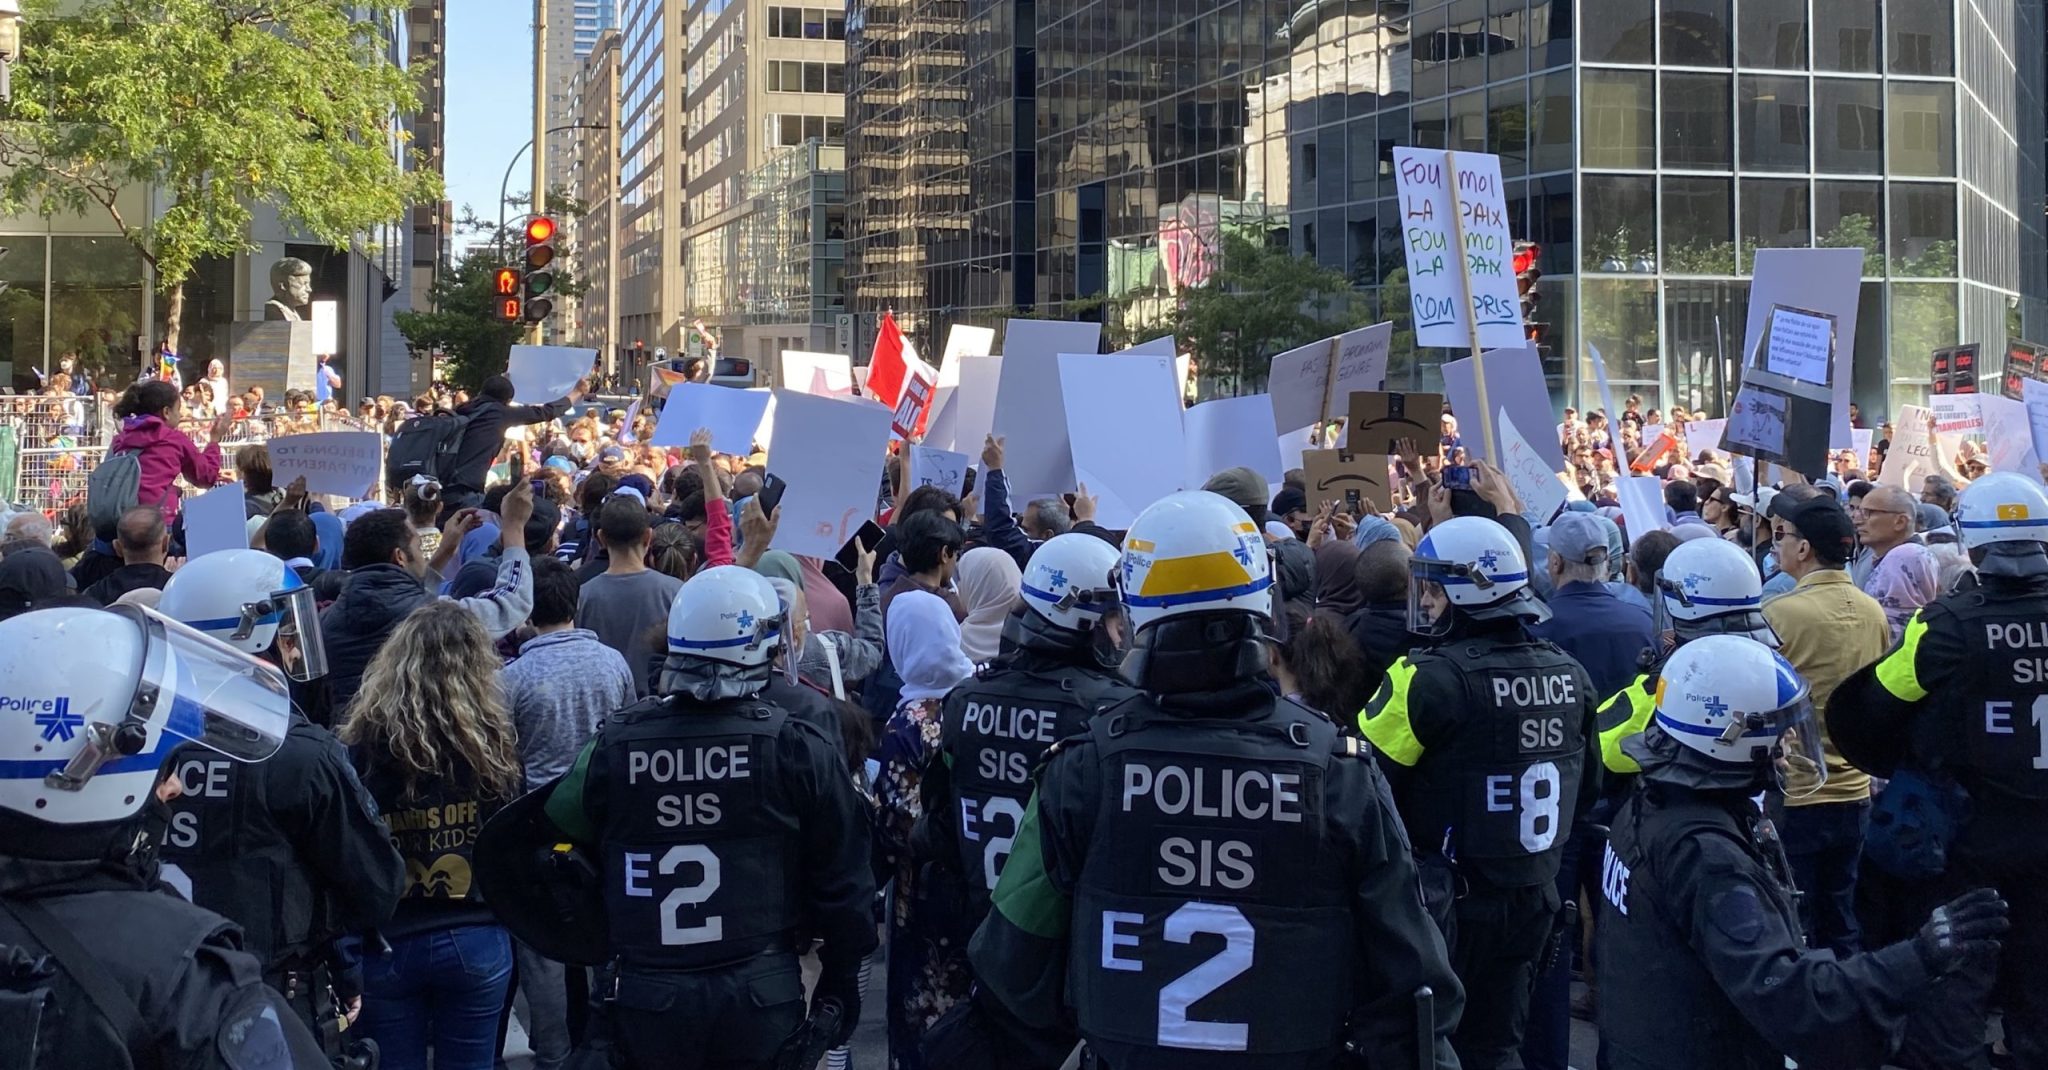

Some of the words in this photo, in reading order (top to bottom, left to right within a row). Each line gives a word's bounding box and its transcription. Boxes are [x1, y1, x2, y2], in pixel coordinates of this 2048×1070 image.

[1400, 157, 1441, 189] FOU
[1407, 195, 1433, 221] LA
[1408, 227, 1447, 253] FOU
[1416, 256, 1444, 276] LA
[1130, 552, 1152, 568] Police
[1985, 622, 2048, 649] POLI
[1492, 674, 1576, 707] POLICE
[1686, 693, 1713, 703] Police
[961, 701, 1058, 743] POLICE
[1520, 717, 1564, 749] SIS
[1985, 701, 2014, 734] E
[628, 744, 751, 785] POLICE
[977, 747, 1028, 784] SIS
[1122, 763, 1302, 823] POLICE
[1486, 774, 1513, 812] E
[1519, 761, 1561, 853] 8
[444, 801, 478, 825] OFF
[656, 792, 722, 828] SIS
[960, 796, 980, 842] E
[429, 825, 477, 852] KIDS
[1157, 836, 1255, 889] SIS
[624, 852, 653, 897] E
[658, 843, 723, 946] 2
[1101, 910, 1145, 972] E
[1157, 901, 1256, 1051] 2
